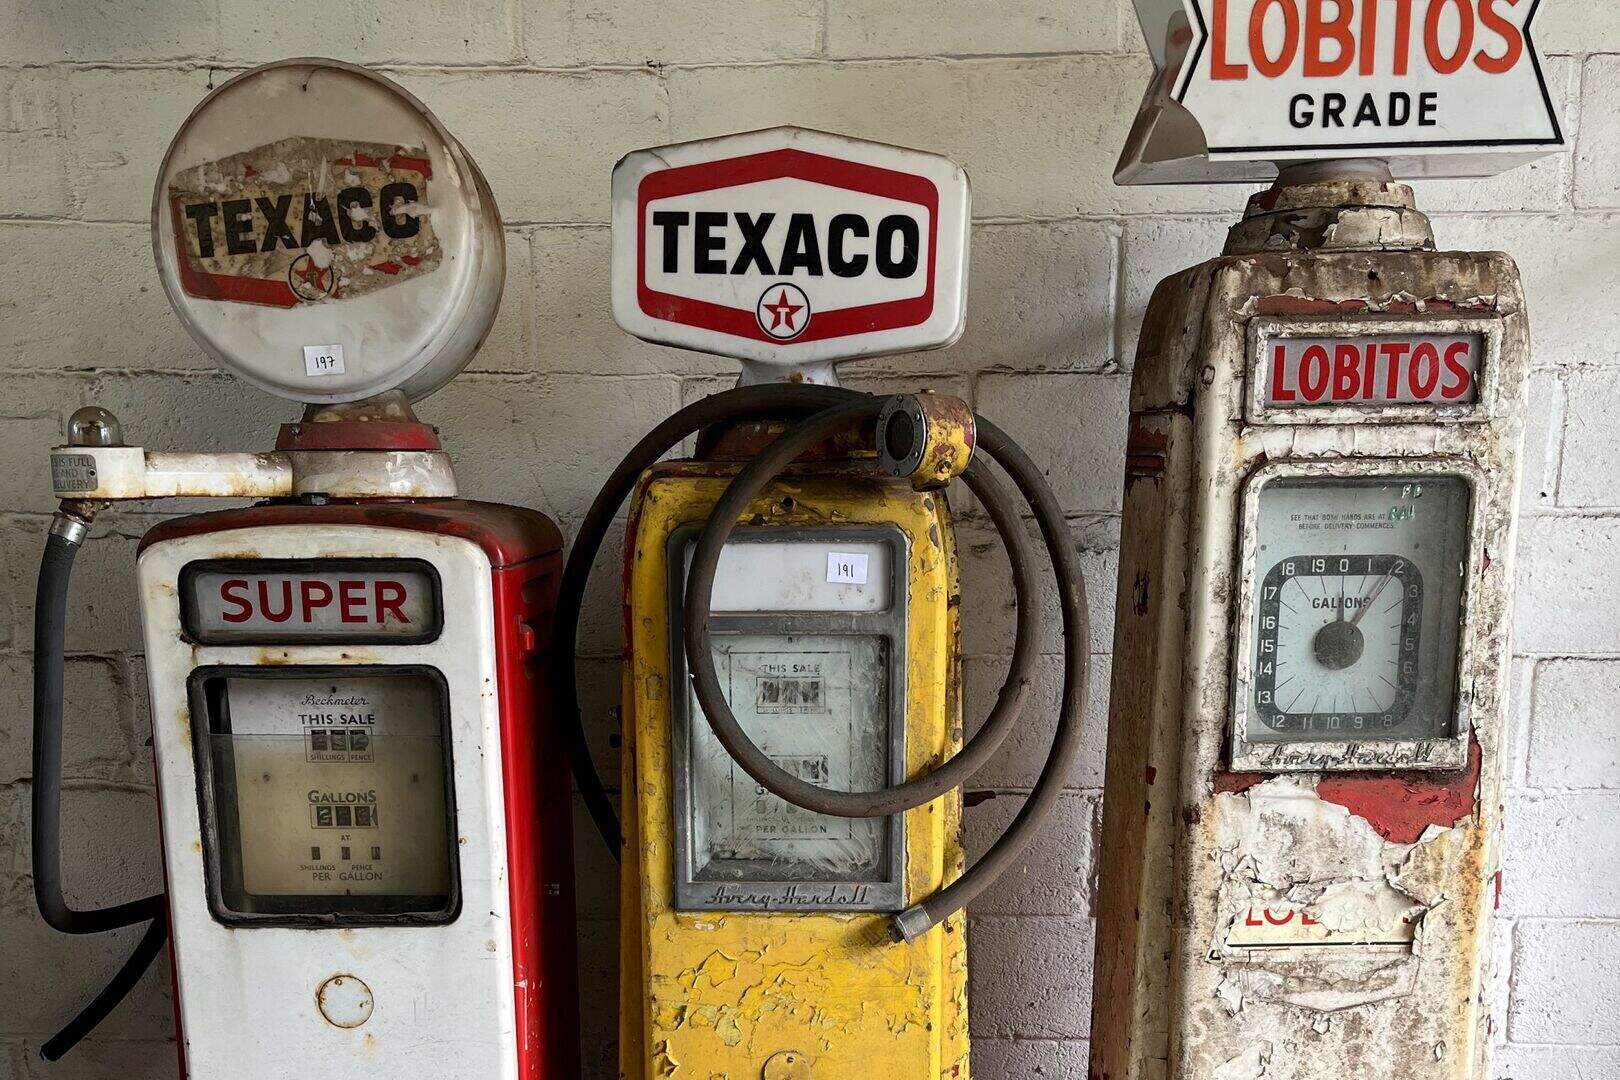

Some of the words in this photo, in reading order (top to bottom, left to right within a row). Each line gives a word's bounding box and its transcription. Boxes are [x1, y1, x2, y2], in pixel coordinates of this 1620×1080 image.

[1289, 92, 1439, 129] GRADE
[653, 211, 920, 279] TEXACO
[314, 356, 335, 369] 197
[1272, 342, 1470, 402] LOBITOS
[837, 563, 854, 578] 191
[1281, 562, 1296, 576] 18
[1311, 559, 1326, 573] 19
[1394, 561, 1405, 575] 2
[1263, 587, 1278, 600] 17
[1408, 585, 1419, 597] 3
[220, 579, 411, 624] SUPER
[1262, 616, 1276, 630] 16
[1405, 615, 1416, 628] 4
[1260, 639, 1275, 653] 15
[1404, 638, 1415, 651] 5
[1259, 662, 1273, 675] 14
[301, 694, 370, 706] Beckmeter
[1257, 691, 1271, 704] 13
[298, 714, 333, 724] THIS
[340, 714, 375, 724] SALE
[1272, 714, 1285, 729] 12
[1303, 716, 1314, 730] 11
[1326, 716, 1340, 730] 10
[1353, 716, 1364, 729] 9
[1383, 714, 1393, 728] 8
[308, 789, 376, 803] GALLONS
[313, 872, 332, 881] PER
[339, 872, 383, 881] GALLON
